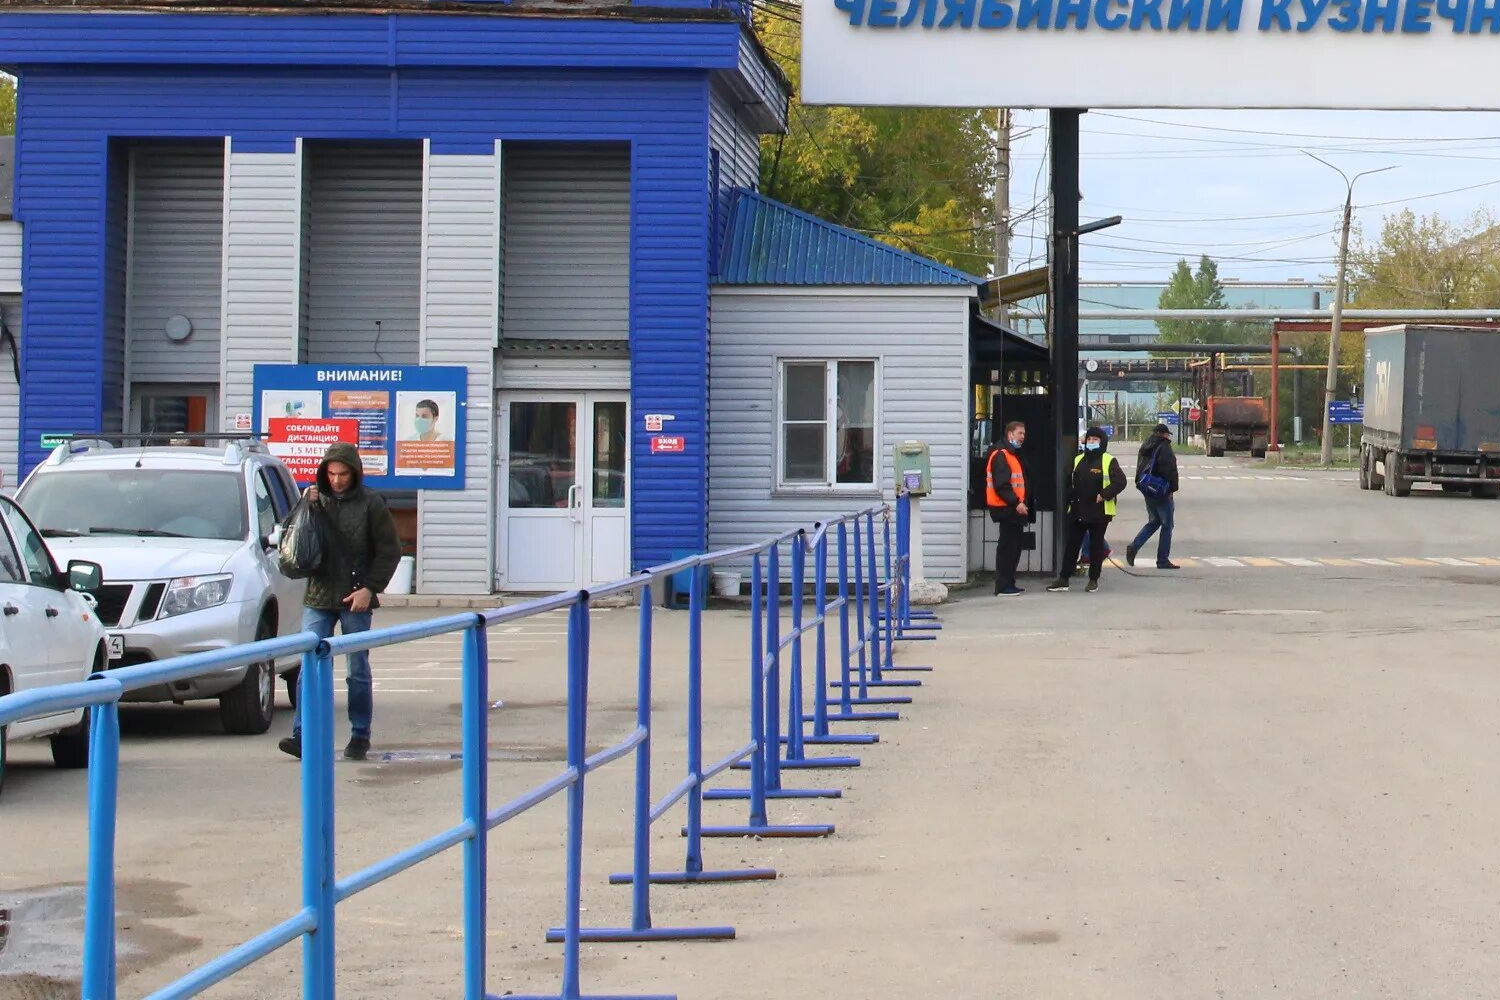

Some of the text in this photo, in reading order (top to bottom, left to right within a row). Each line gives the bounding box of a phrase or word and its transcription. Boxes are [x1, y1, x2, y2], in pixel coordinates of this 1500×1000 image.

[317, 370, 402, 382] ВНИМАНИЕ!
[285, 424, 340, 433] СОБЛЮДАЙТЕ
[286, 434, 339, 443] ДИСТАНЦИЮ
[304, 446, 329, 455] МЕТР
